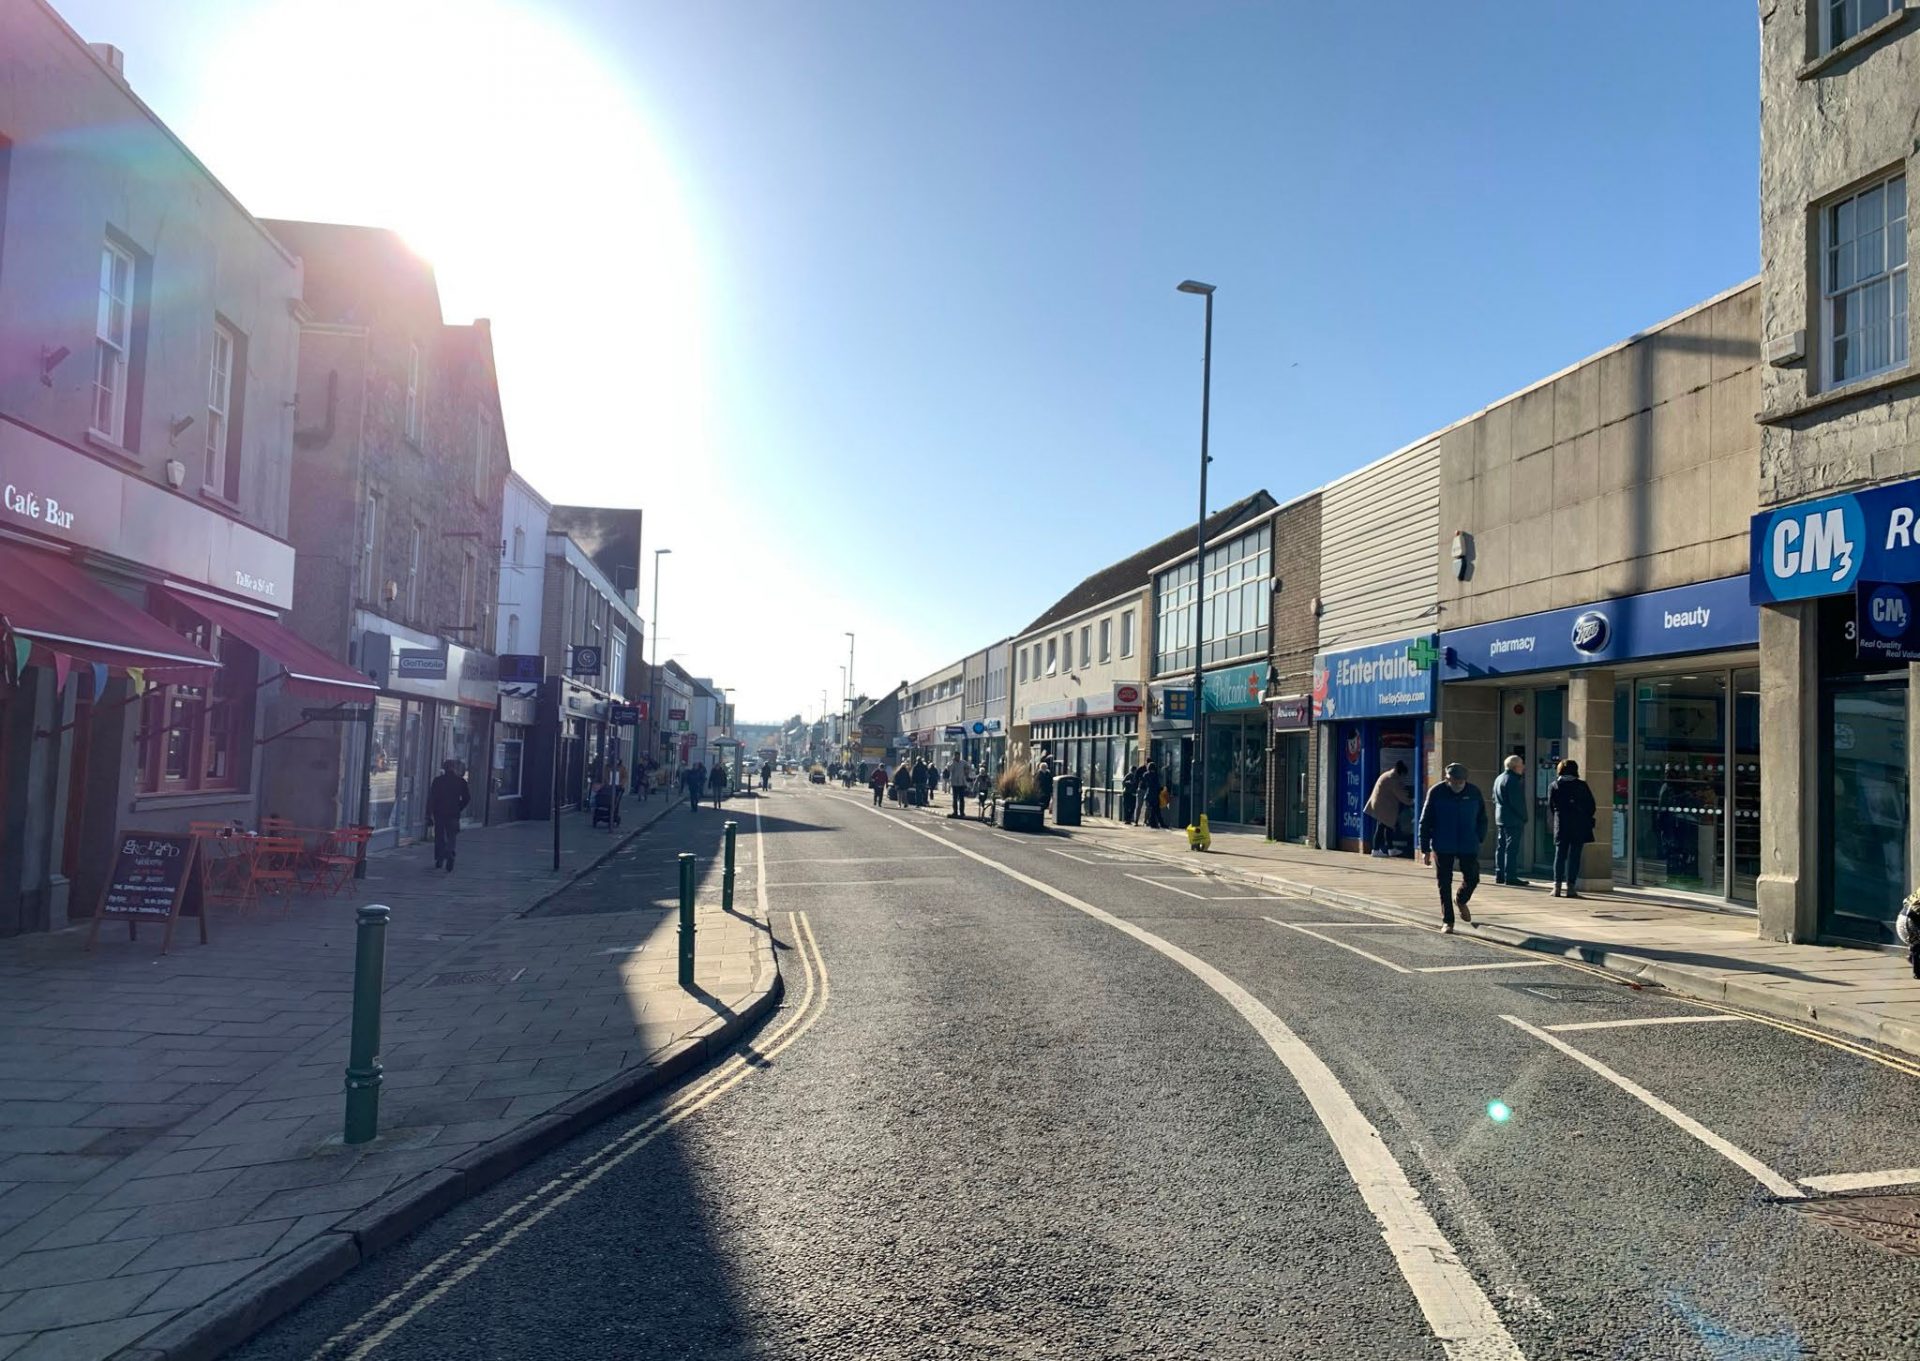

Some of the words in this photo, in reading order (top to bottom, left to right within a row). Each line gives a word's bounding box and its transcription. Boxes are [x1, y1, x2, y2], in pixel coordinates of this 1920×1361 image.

[45, 497, 74, 529] Bar
[1664, 606, 1711, 629] beauty
[1490, 636, 1536, 657] pharmacy
[1860, 638, 1876, 648] Real
[1876, 640, 1902, 650] Quality
[1886, 649, 1902, 658] Real
[1343, 647, 1422, 686] Entertaine
[1347, 770, 1360, 785] The
[1347, 791, 1359, 809] Toy
